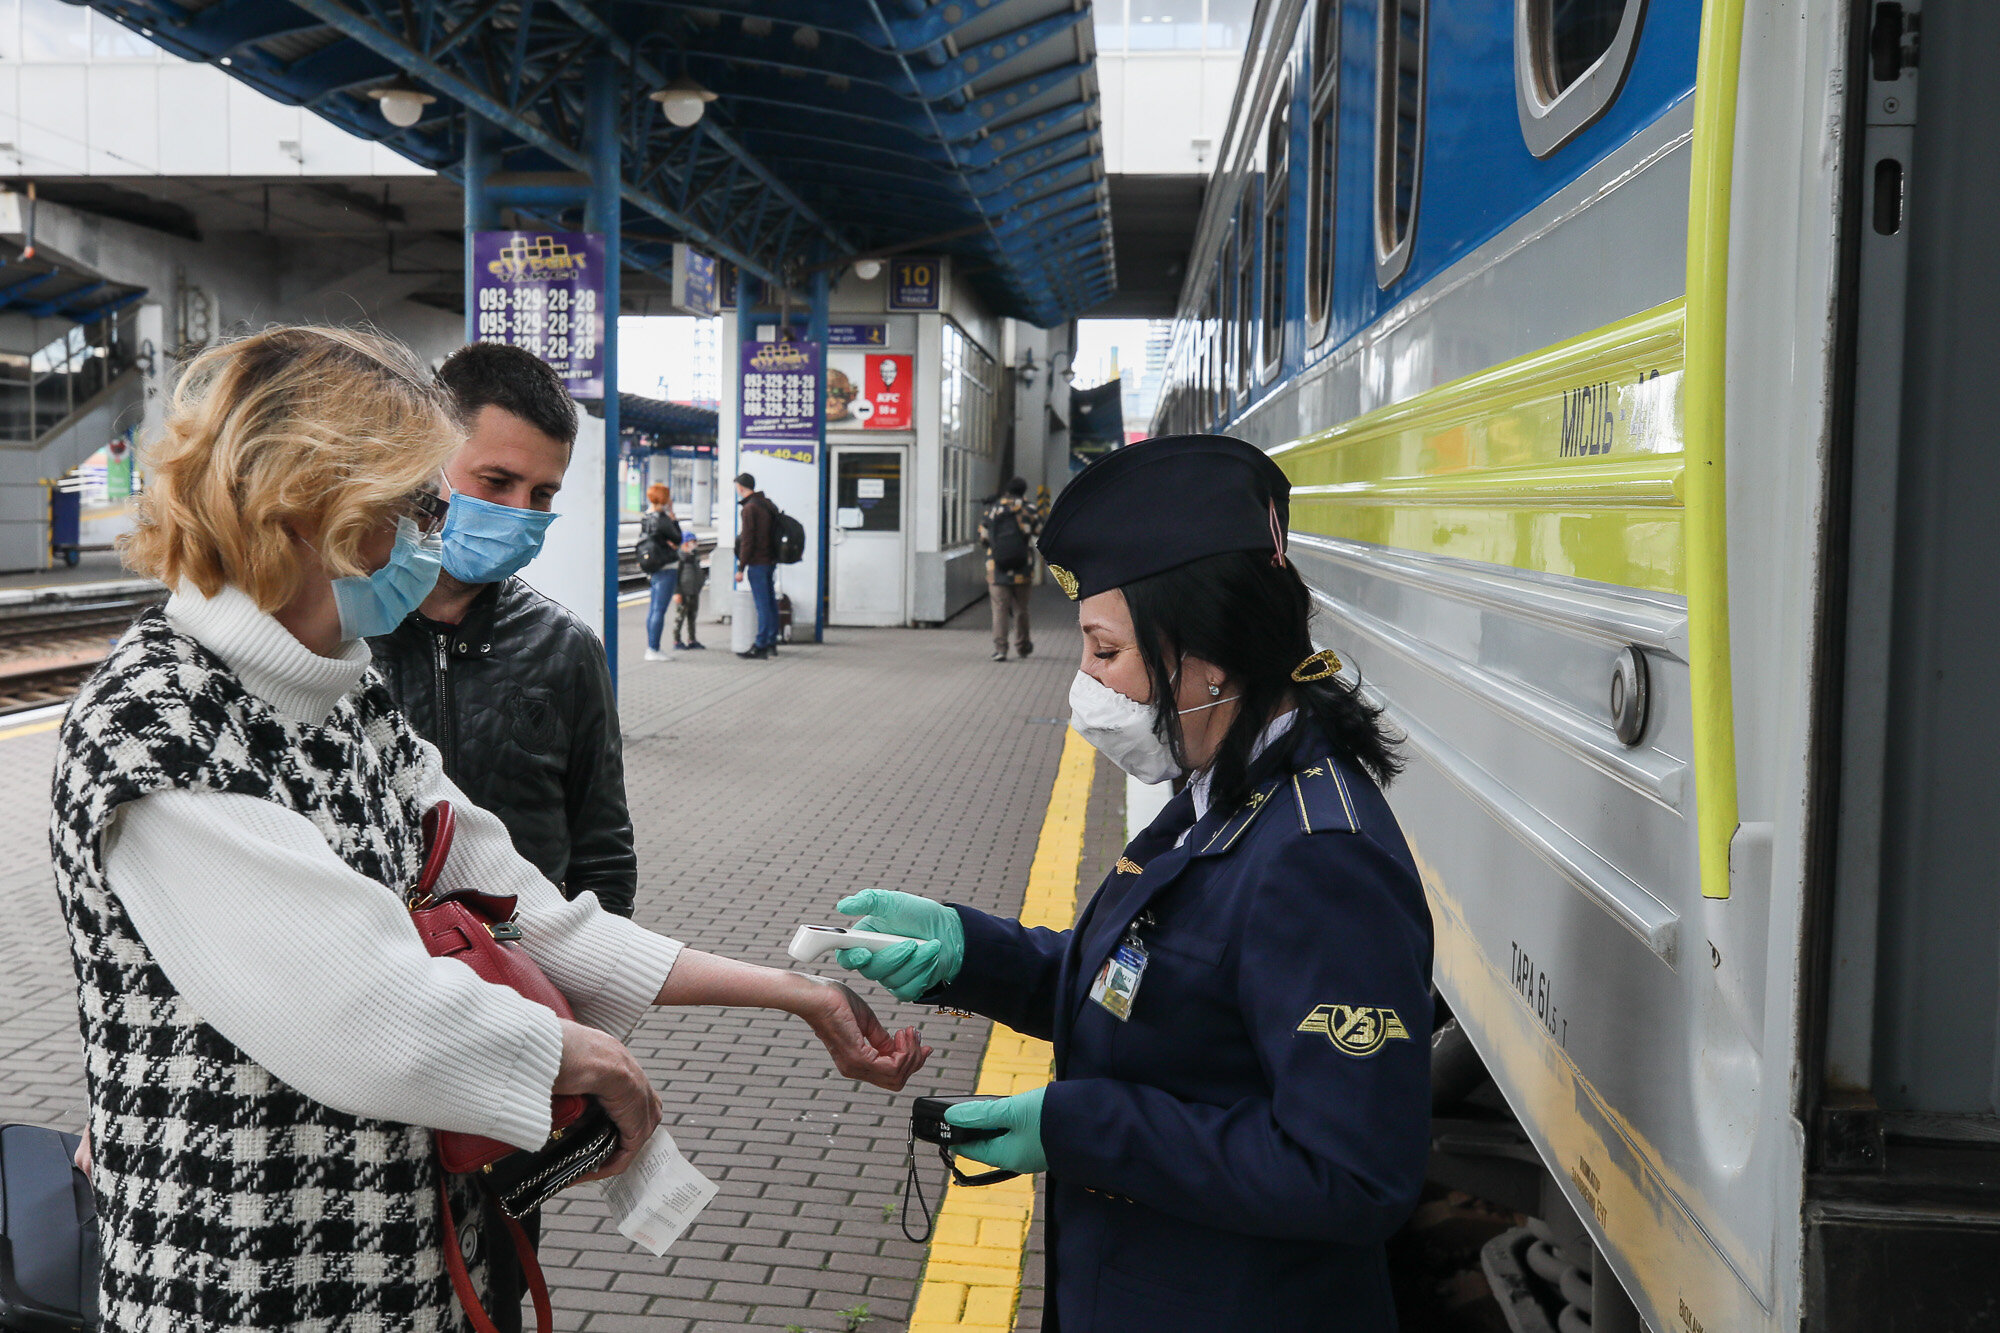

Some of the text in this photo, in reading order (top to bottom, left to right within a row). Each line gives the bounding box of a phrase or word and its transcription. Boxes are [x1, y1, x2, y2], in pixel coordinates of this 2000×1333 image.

[901, 266, 931, 287] 10
[479, 287, 596, 312] 093-329-28-28
[479, 311, 596, 336] 095-329-28-28
[876, 393, 901, 403] KFC
[1560, 381, 1614, 457] МІСЦЬ
[1511, 940, 1534, 1008] ТАРА
